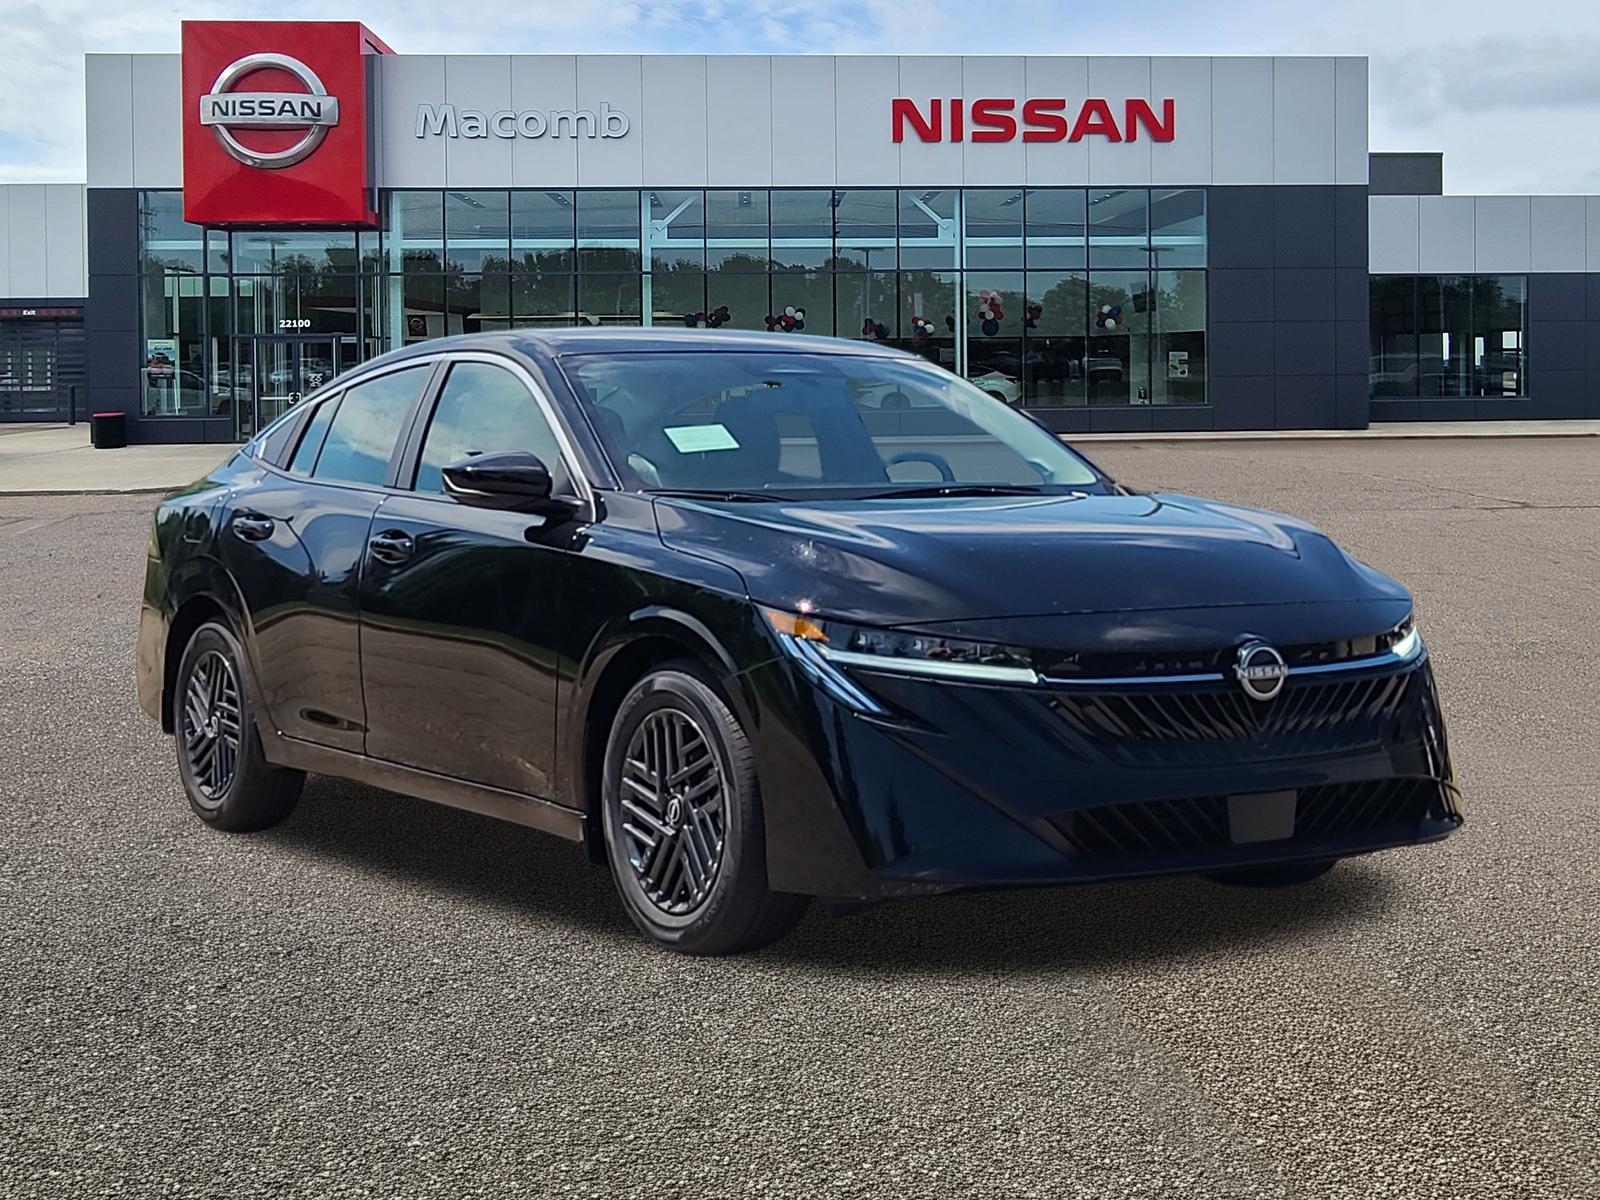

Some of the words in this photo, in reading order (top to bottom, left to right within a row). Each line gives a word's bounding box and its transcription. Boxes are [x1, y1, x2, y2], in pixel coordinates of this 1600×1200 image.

[211, 98, 323, 120] NISSAN
[415, 101, 631, 139] Macomb
[892, 98, 1176, 143] NISSAN
[279, 319, 310, 328] 22100
[1237, 665, 1288, 679] NISSAN
